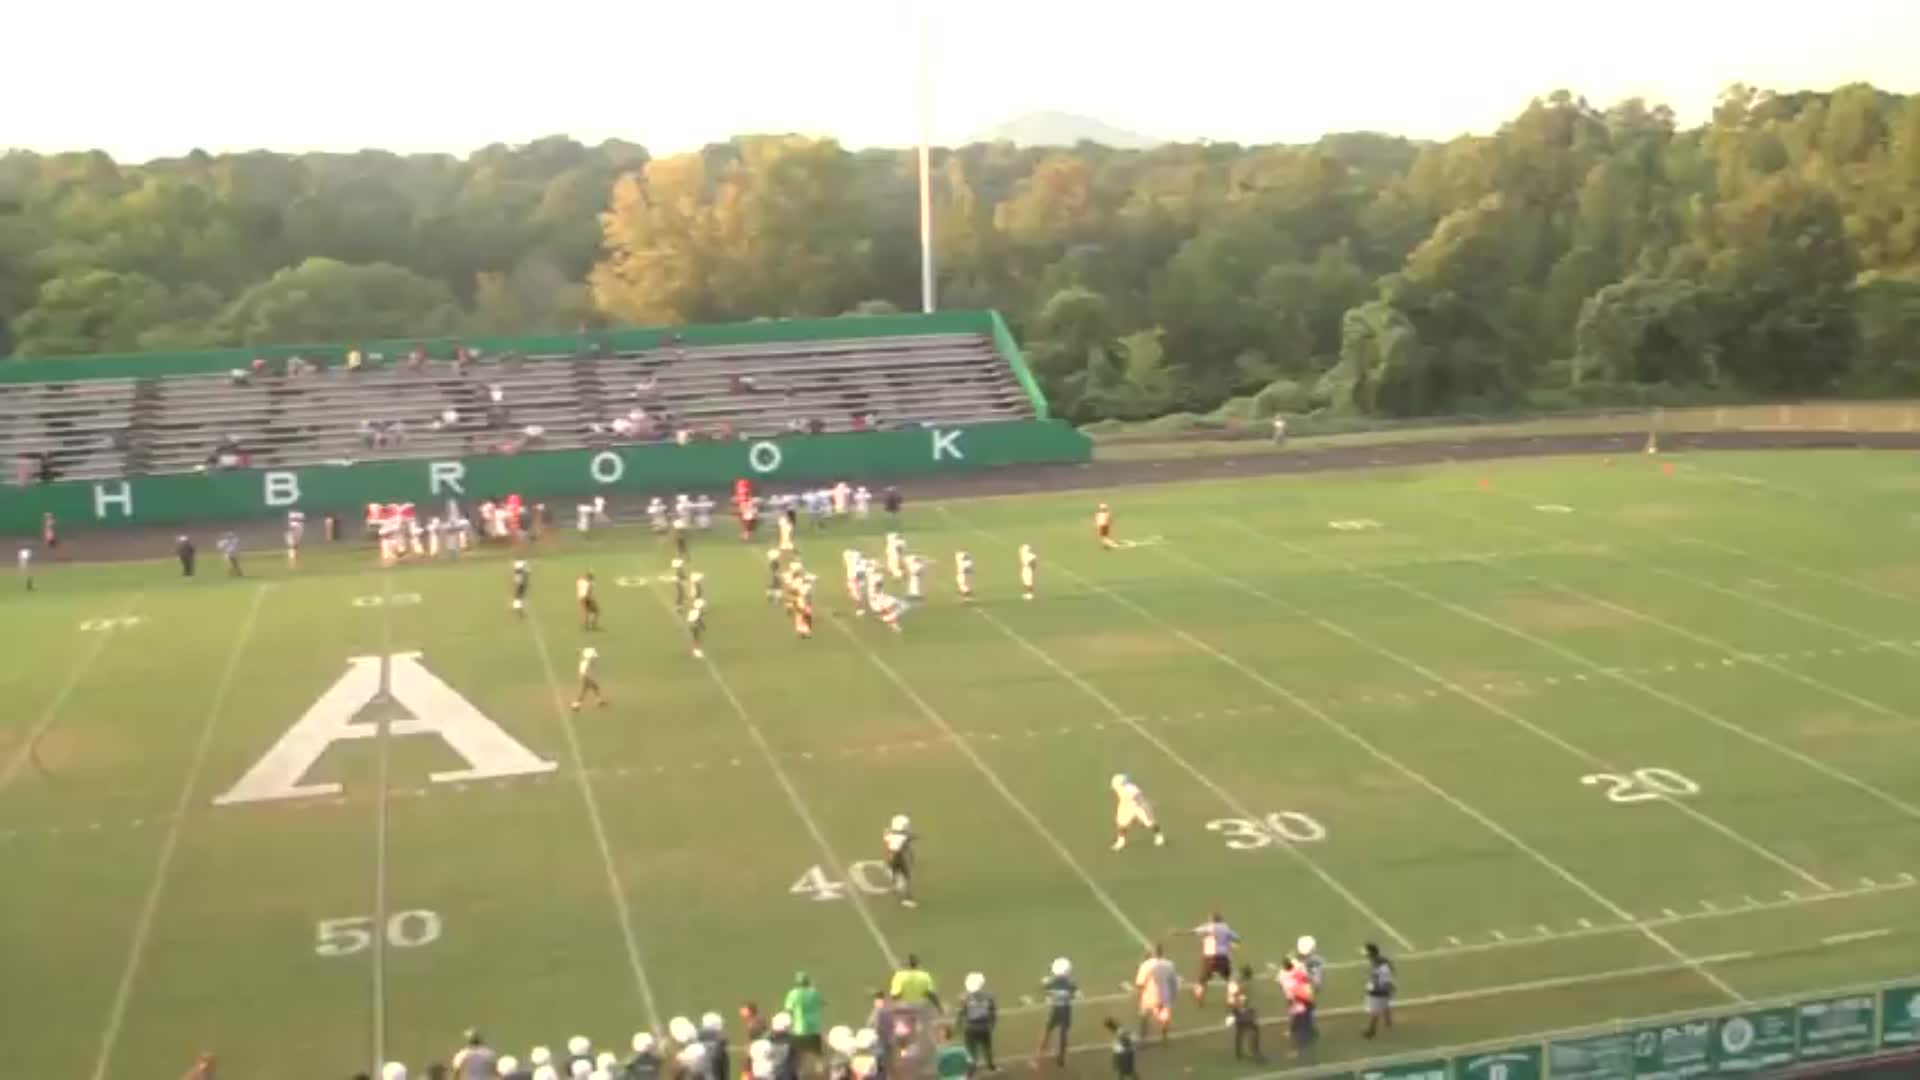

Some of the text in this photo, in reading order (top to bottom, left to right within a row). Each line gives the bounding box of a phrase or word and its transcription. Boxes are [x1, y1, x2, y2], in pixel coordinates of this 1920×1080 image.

[1580, 767, 1700, 803] 20
[1205, 811, 1327, 850] 30
[789, 859, 896, 900] 40
[314, 908, 442, 957] 50
